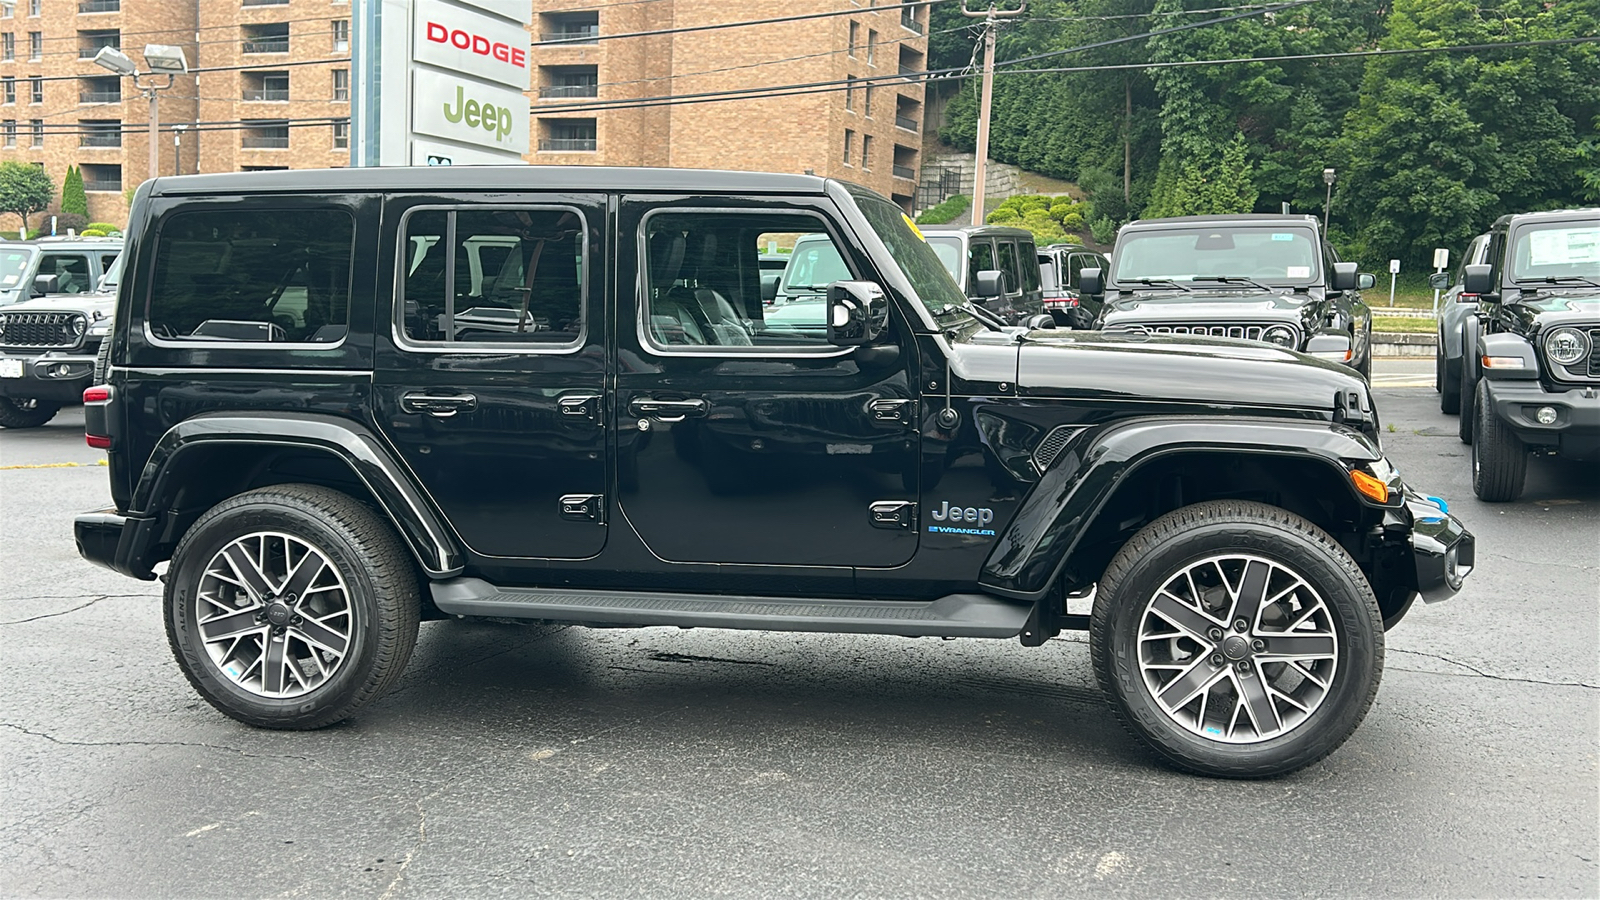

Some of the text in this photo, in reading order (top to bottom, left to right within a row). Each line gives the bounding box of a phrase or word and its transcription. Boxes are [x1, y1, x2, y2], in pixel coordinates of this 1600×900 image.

[427, 21, 525, 68] DODGE
[443, 85, 512, 142] Jeep
[931, 501, 994, 527] Jeep
[939, 526, 995, 535] WRANGLER
[176, 589, 187, 633] ALENZA
